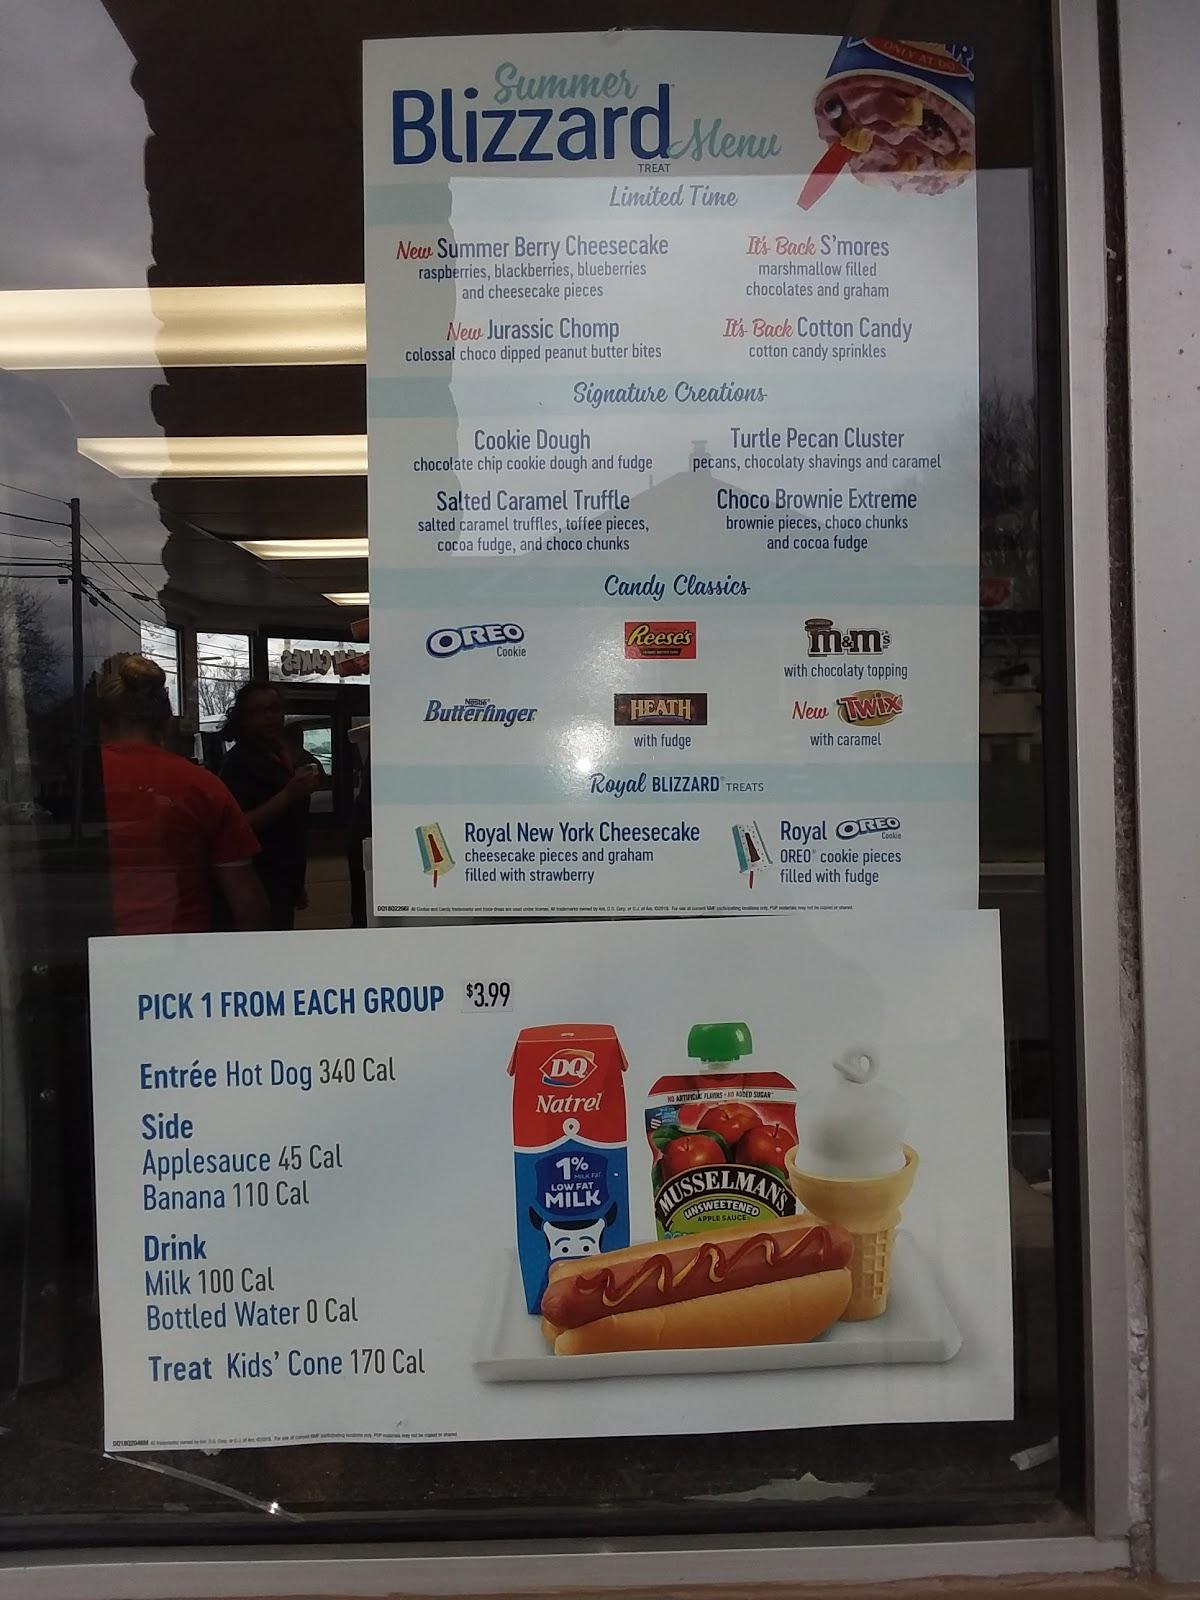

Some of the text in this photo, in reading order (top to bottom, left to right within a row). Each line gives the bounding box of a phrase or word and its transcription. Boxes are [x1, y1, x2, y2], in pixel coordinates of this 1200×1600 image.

[494, 62, 640, 104] Summer
[392, 83, 670, 165] Blizzard
[667, 118, 782, 160] Menu
[638, 163, 670, 173] TREAT
[609, 185, 738, 207] Limited Time
[396, 234, 668, 263] New Summer Berry Cheesecake
[746, 234, 889, 256] It's Back S'mores
[419, 261, 646, 283] raspberries, blackberries, blueberries
[759, 260, 877, 277] marshmallow filled
[746, 281, 889, 300] chocolates and graham
[446, 317, 619, 343] New Jurassic Chomp
[722, 316, 912, 343] It's Back Cotton Candy
[405, 343, 661, 363] colossal choco dipped peanut butter bites
[749, 343, 886, 361] cotton candy sprinkles
[573, 381, 768, 408] Signature Creations
[475, 429, 590, 454] Cookie Dough
[730, 427, 905, 448] Turtle Pecan Cluster
[413, 453, 653, 474] chocolate chip cookie dough and fudge
[693, 453, 941, 473] pecans, chocolaty shavings and caramel
[437, 489, 630, 512] Salted Caramel Truffle
[717, 488, 917, 509] Choco Brownie Extreme
[418, 515, 649, 534] salted caramel truffles, toffee pieces,
[726, 514, 908, 533] brownie pieces, choco chunks
[437, 536, 630, 554] cocoa fudge, and choco chunks
[604, 574, 751, 602] Candy Classics
[426, 623, 524, 658] OREO
[627, 624, 693, 646] Reese's
[497, 645, 526, 657] Cookie
[784, 663, 908, 680] with chocolaty topping
[424, 699, 537, 727] Butterfinger
[630, 698, 691, 721] HEATH
[792, 701, 829, 720] New
[591, 772, 647, 798] Royal
[726, 783, 764, 792] TREATS
[465, 821, 700, 846] Royal New York Cheesecake
[780, 817, 900, 845] Royal OREO
[465, 847, 653, 865] cheesecake pieces and graham
[820, 848, 859, 863] cookie
[863, 848, 901, 866] pieces
[465, 867, 595, 885] filled with strawberry
[138, 986, 444, 1020] PICK 1 FROM EACH GROUP
[466, 982, 511, 1009] $3.99
[140, 1057, 396, 1091] Entrée Hot Dog 340 Cal
[550, 1057, 588, 1078] DQ
[536, 1093, 602, 1113] Natrel
[142, 1112, 193, 1140] Side
[143, 1143, 343, 1181] Applesauce 45 Cal
[555, 1157, 589, 1180] 1%
[144, 1180, 309, 1210] Banana 110 Cal
[551, 1181, 594, 1192] LOW FAT
[659, 1170, 788, 1216] MUSSELMAN'S
[545, 1189, 601, 1208] MILK
[684, 1199, 760, 1219] UNSWEETENED
[698, 1214, 720, 1222] APPLE
[144, 1233, 207, 1262] Drink
[145, 1266, 274, 1296] Milk 100 Cal
[147, 1297, 358, 1331] Bottled Water 0 Cal
[148, 1348, 425, 1382] Treat Kids' Cone 170 Cal
